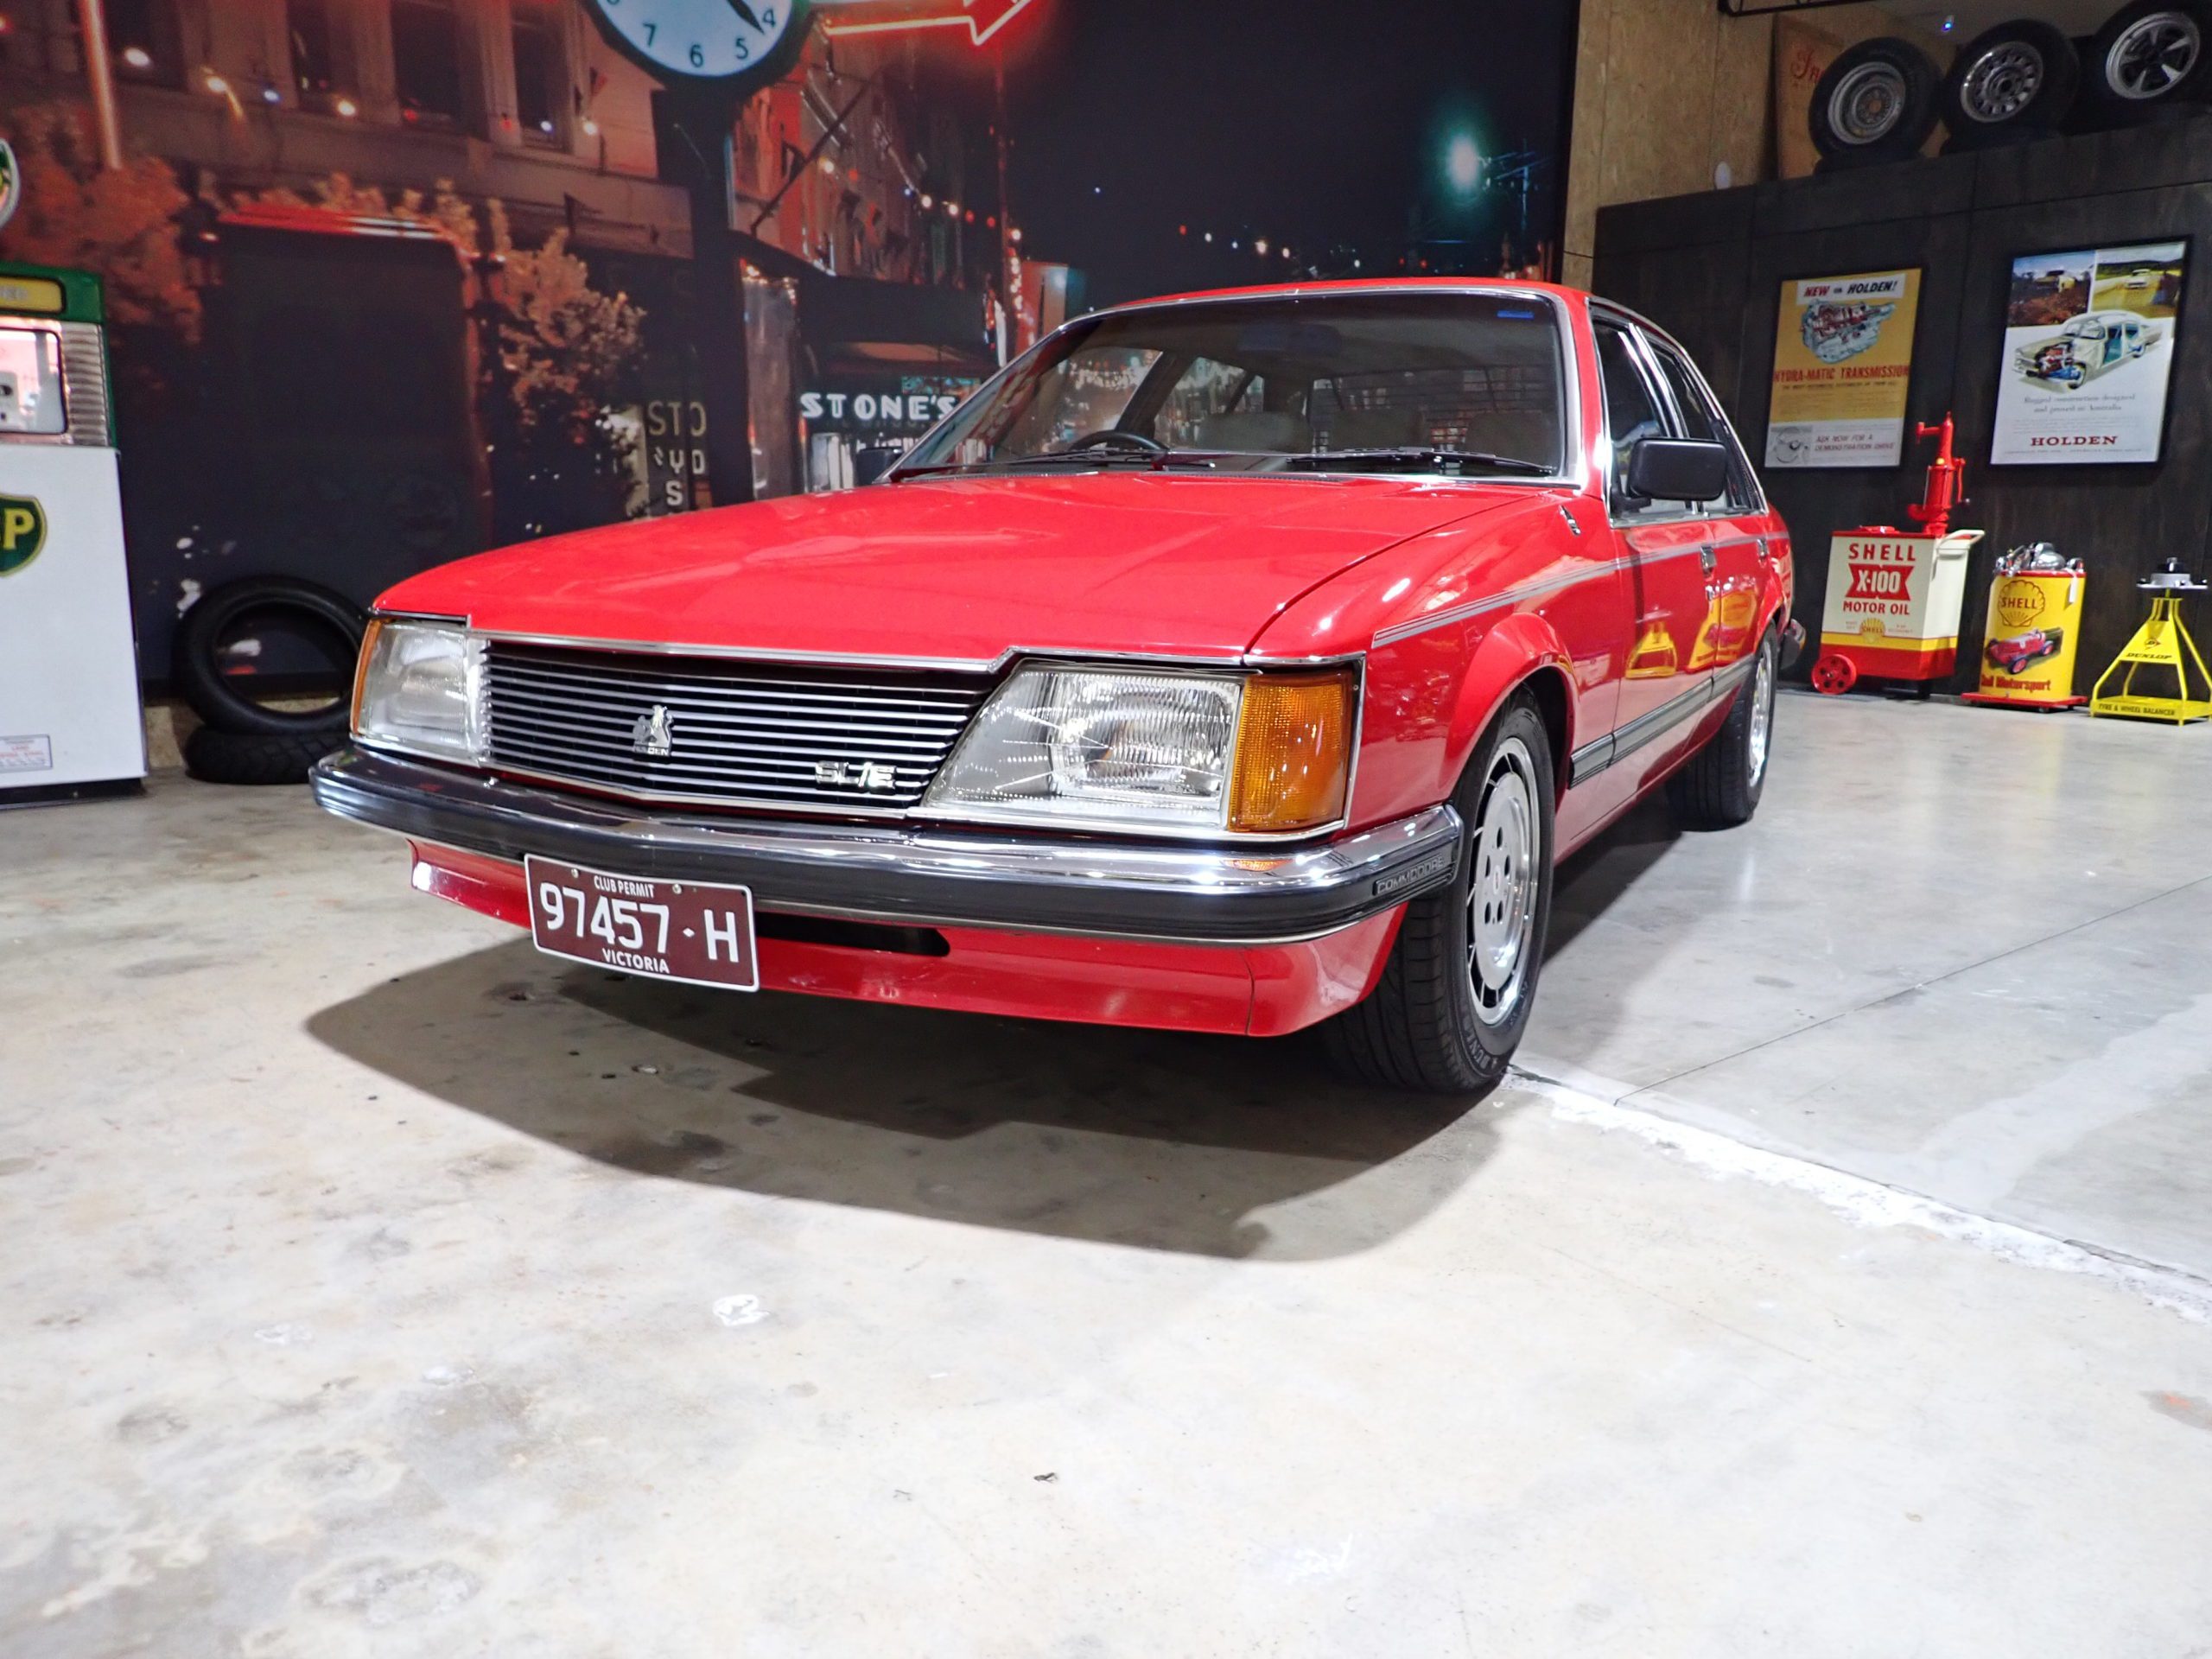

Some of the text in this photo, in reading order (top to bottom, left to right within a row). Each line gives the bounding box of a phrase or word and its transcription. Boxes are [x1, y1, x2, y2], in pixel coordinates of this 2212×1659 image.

[763, 9, 776, 28] 4
[643, 22, 657, 47] 7
[690, 44, 704, 67] 6
[735, 38, 748, 60] 5
[1803, 286, 1830, 297] NEW
[1847, 280, 1897, 295] HOLDEN!
[799, 391, 957, 421] STONE'S
[2031, 435, 2118, 447] HOLDEN
[0, 507, 35, 550] P
[1848, 543, 1916, 562] SHELL
[1842, 601, 1910, 615] MOTOR OIL
[2001, 596, 2037, 609] SHELL
[1996, 675, 2051, 693] Motorsport
[2120, 705, 2141, 714] WHEEL
[2143, 707, 2175, 716] BALANCER
[635, 746, 670, 756] DEN
[1377, 855, 1445, 894] COMMODORE
[594, 875, 654, 899] CLUB PERMIT
[540, 882, 739, 963] 97457 H
[602, 948, 671, 974] VICTORIA
